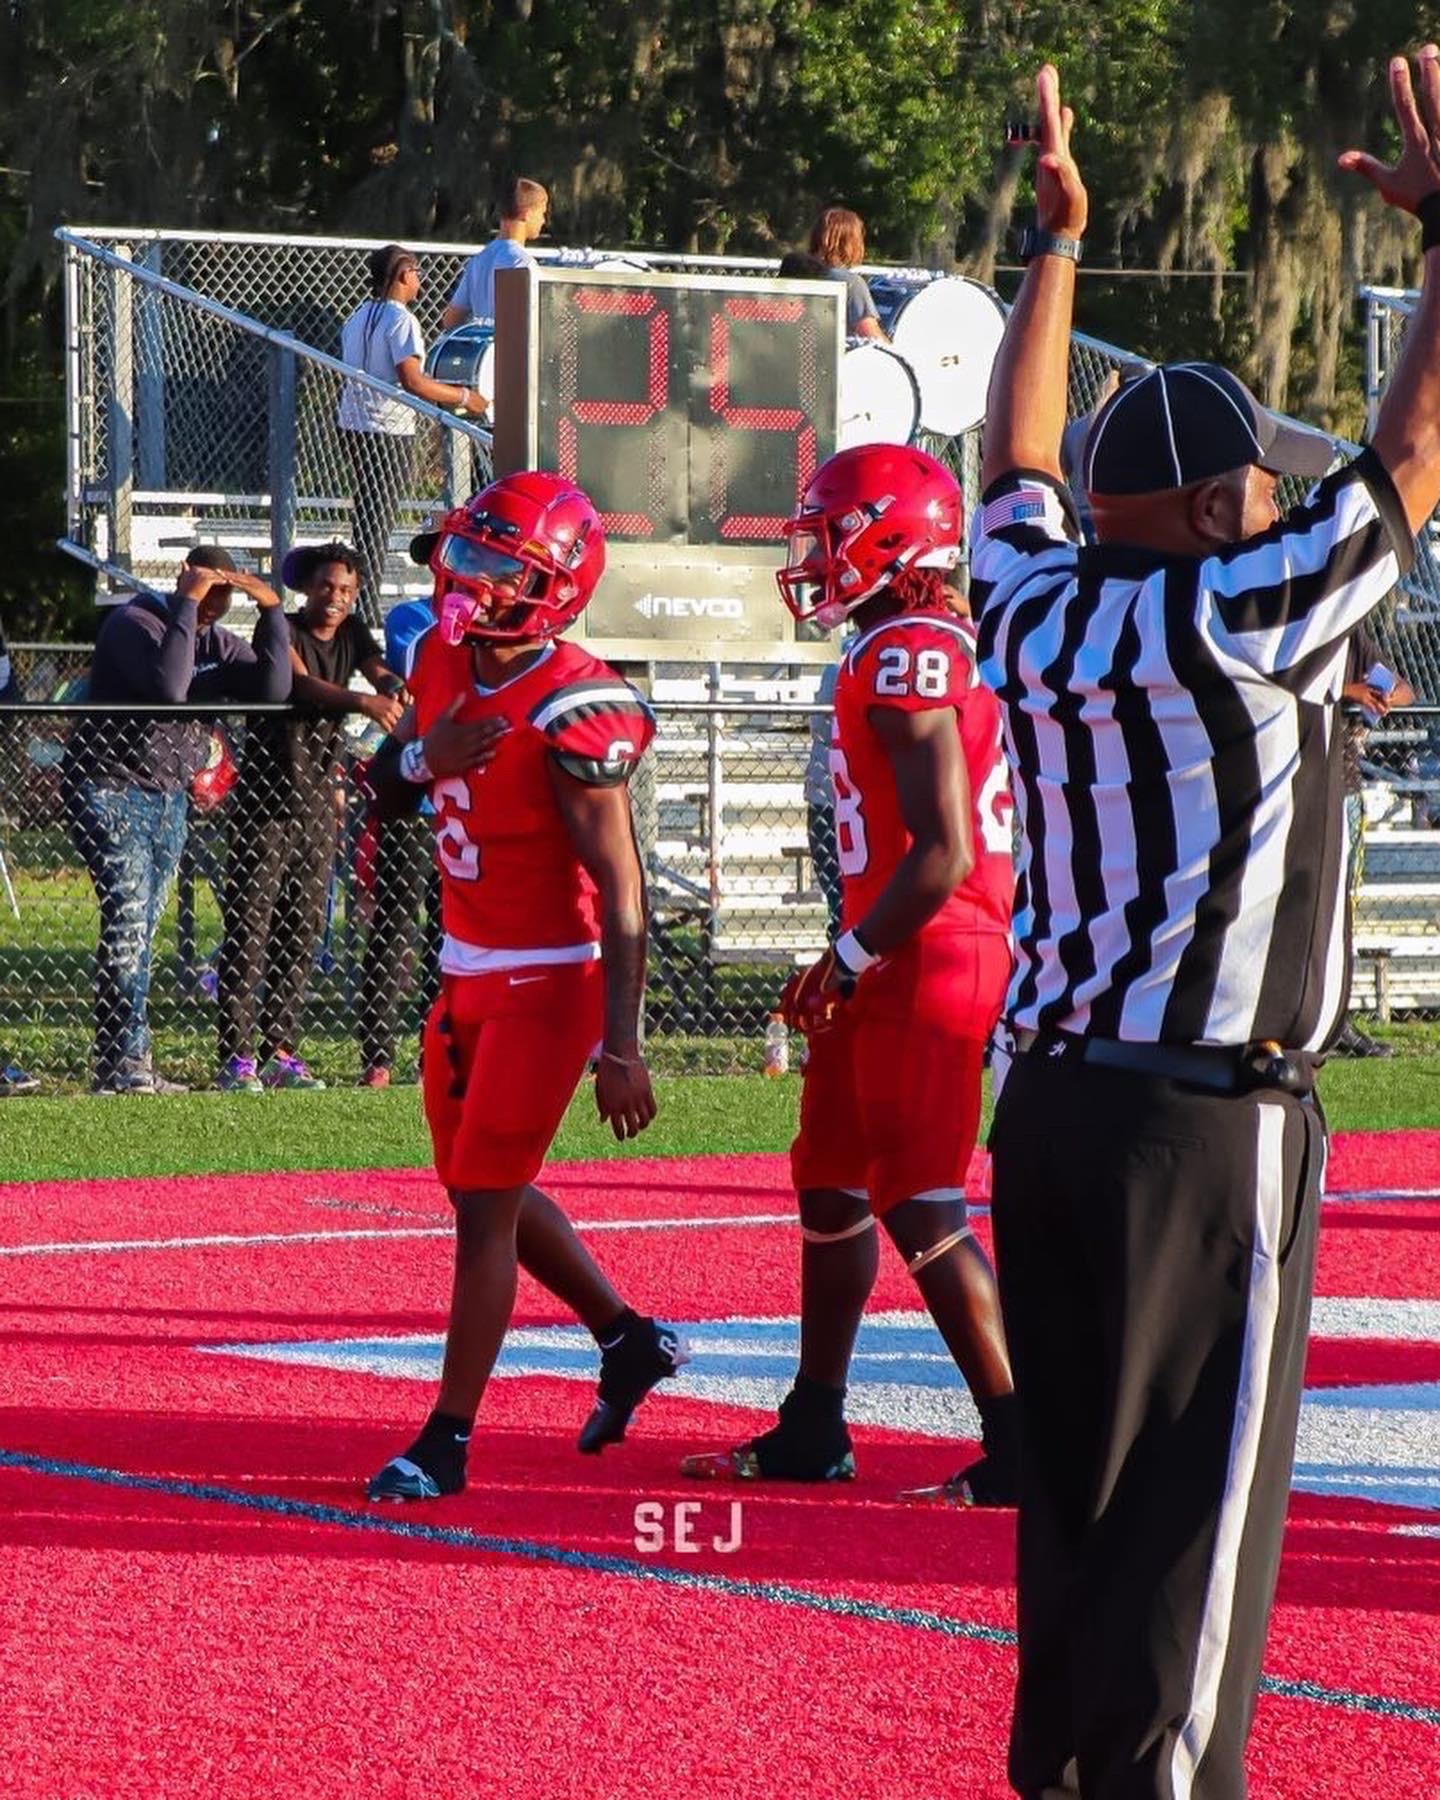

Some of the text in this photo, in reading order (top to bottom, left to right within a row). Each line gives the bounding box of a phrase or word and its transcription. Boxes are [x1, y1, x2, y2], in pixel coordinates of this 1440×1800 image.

[556, 290, 818, 540] 25
[652, 596, 744, 619] NEVCO
[874, 647, 951, 699] 28
[432, 776, 480, 881] 6
